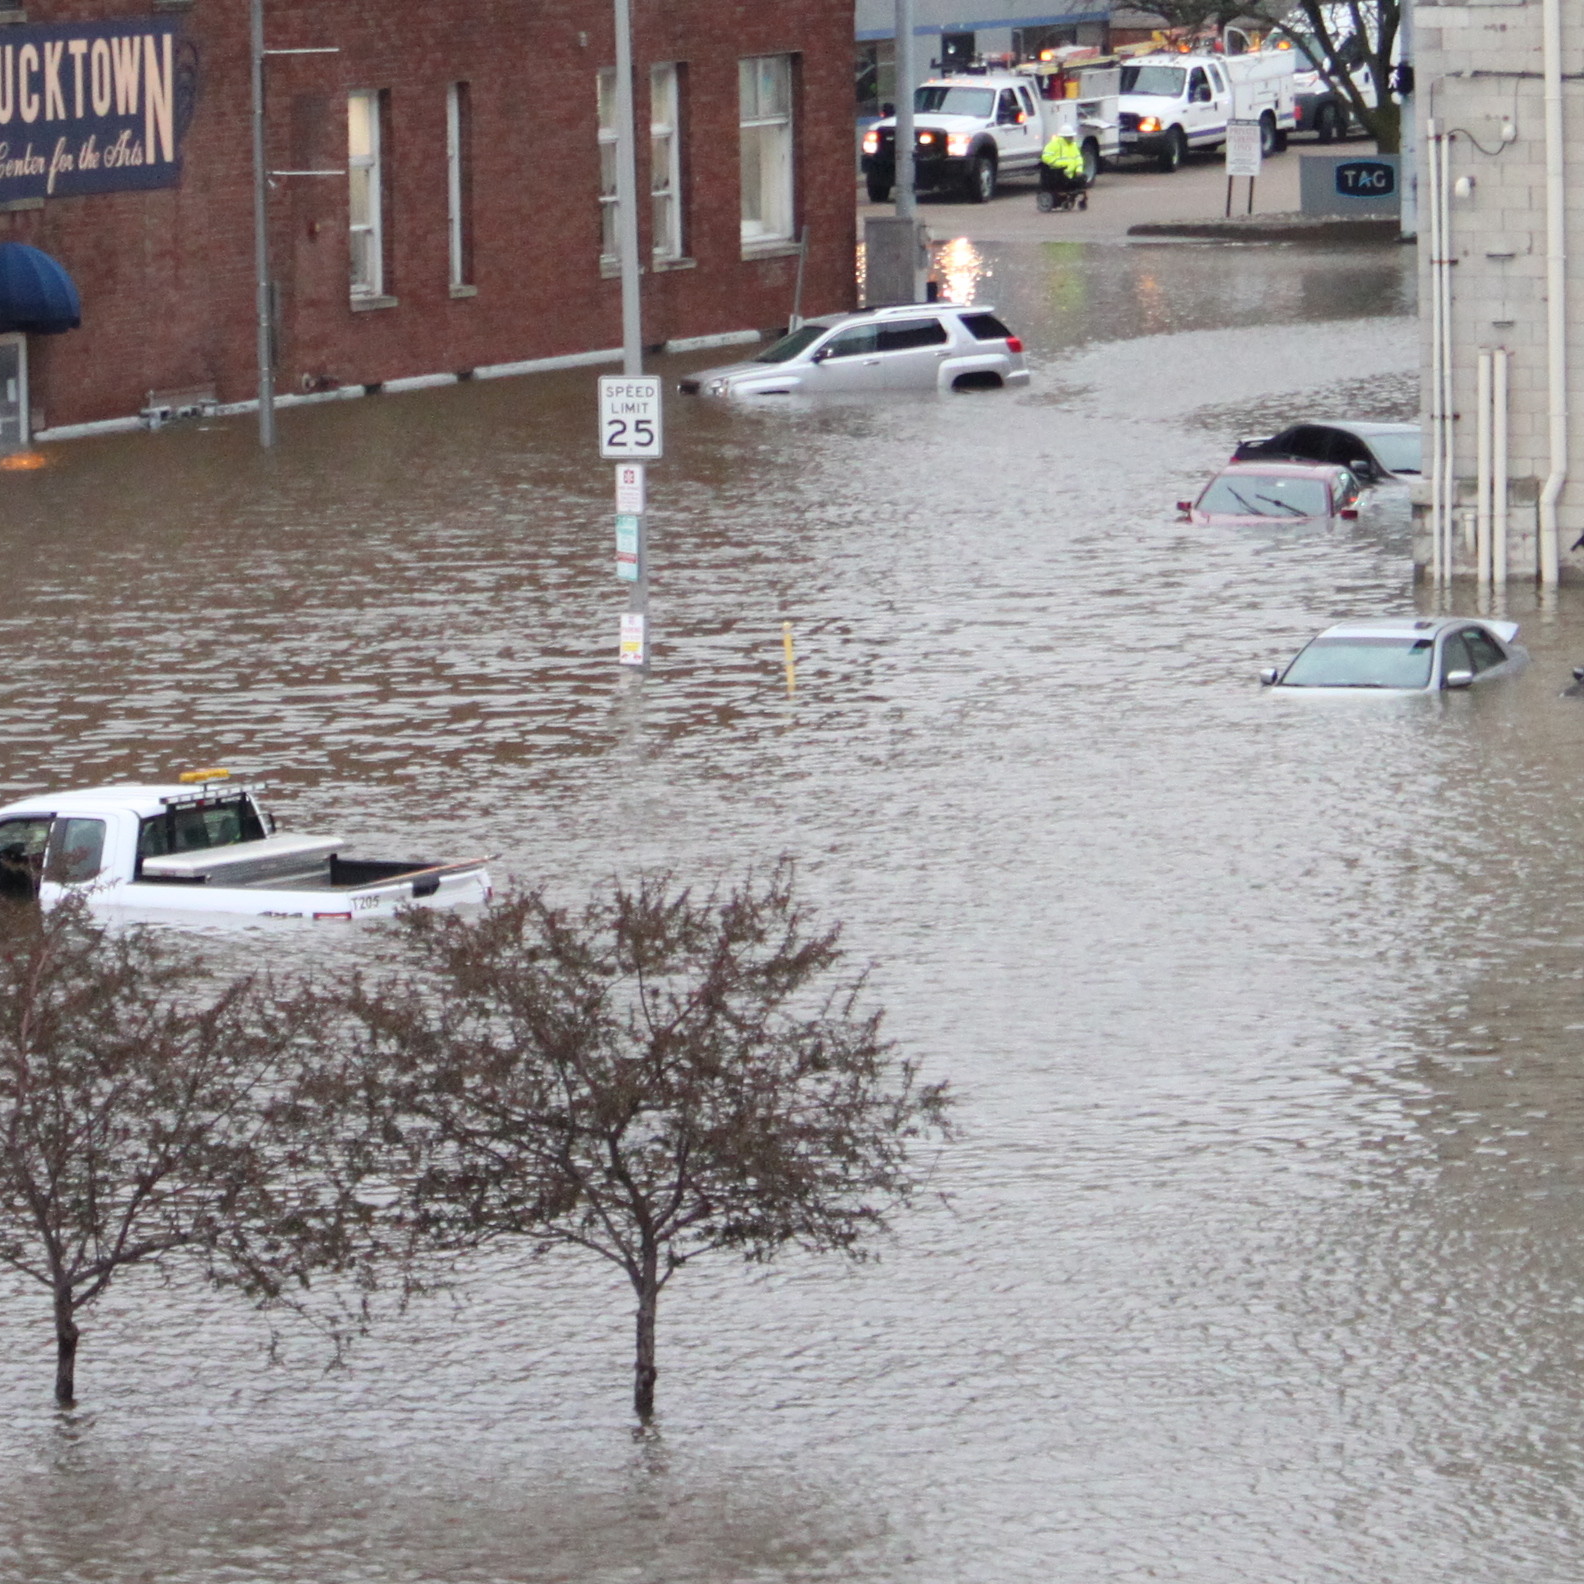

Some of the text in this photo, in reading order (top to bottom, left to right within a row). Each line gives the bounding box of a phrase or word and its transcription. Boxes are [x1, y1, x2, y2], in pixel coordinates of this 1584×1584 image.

[46, 136, 75, 195] for
[78, 134, 100, 170] the
[103, 129, 143, 168] Arts
[1344, 170, 1386, 188] TAG
[606, 385, 655, 398] SPEED
[611, 402, 649, 414] LIMIT
[607, 419, 655, 447] 25
[351, 895, 380, 910] T205
